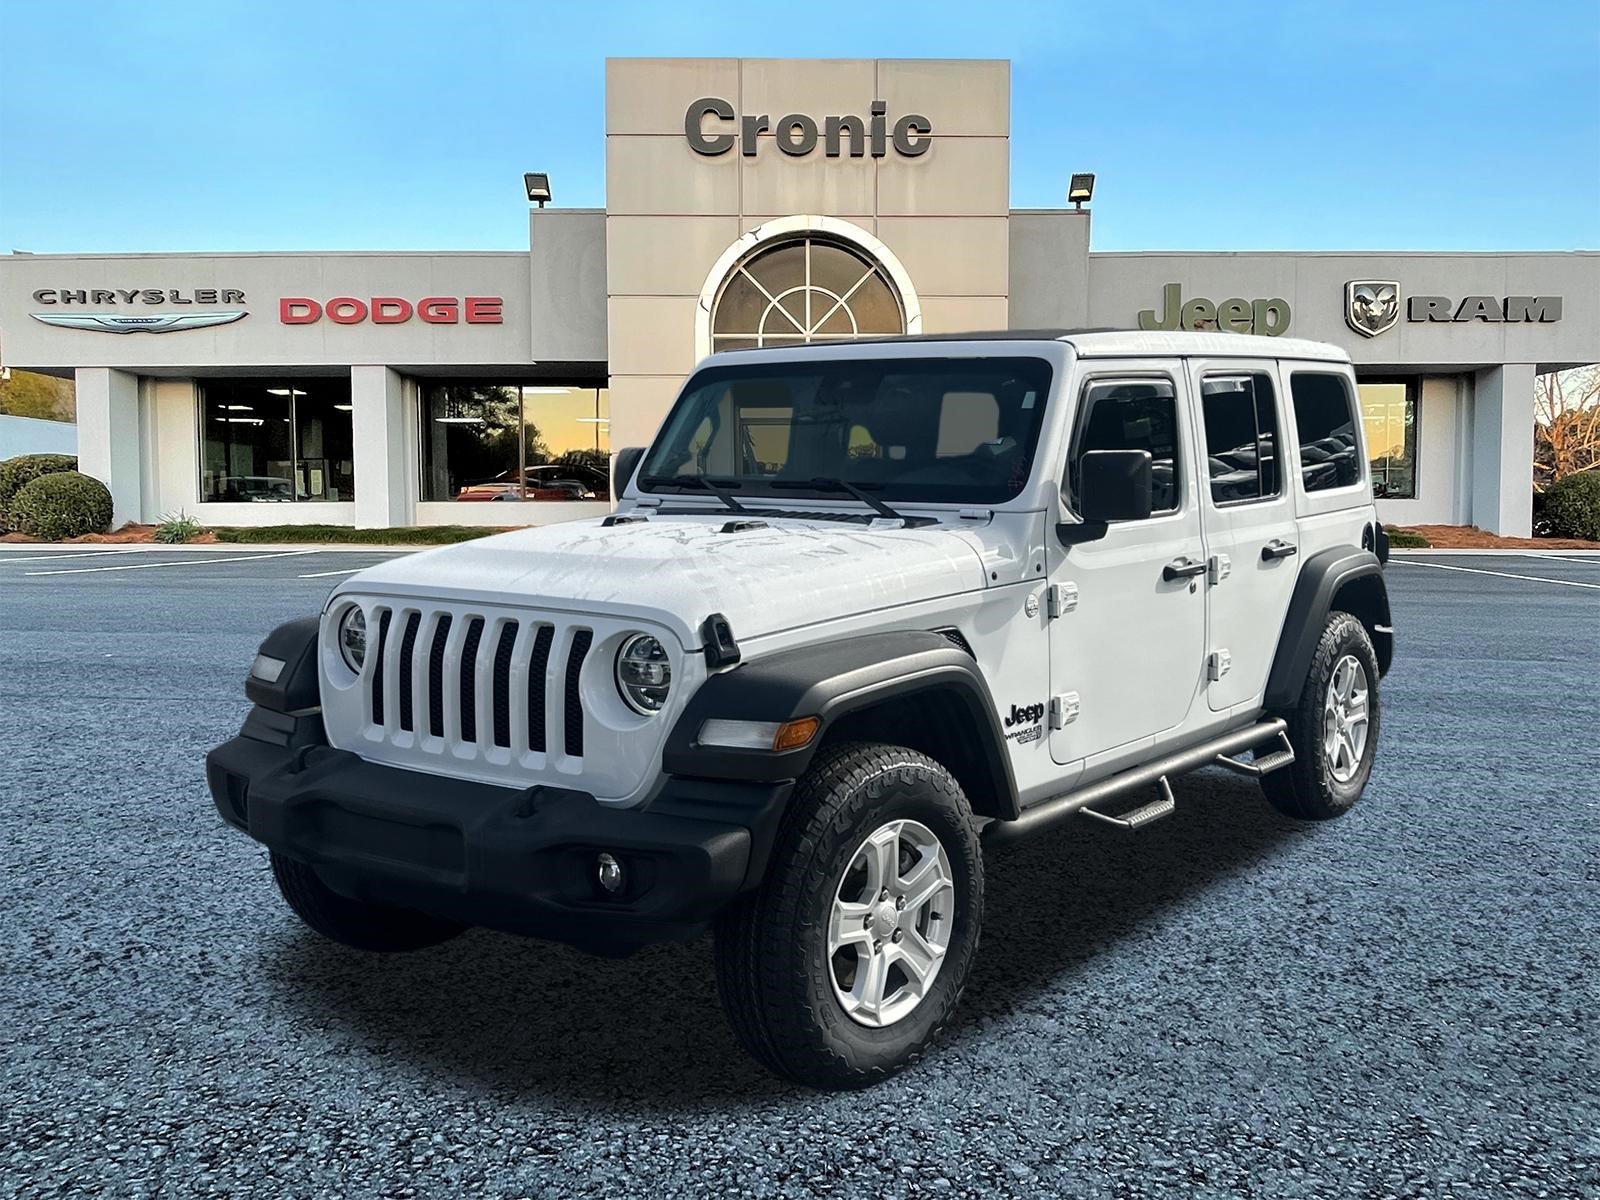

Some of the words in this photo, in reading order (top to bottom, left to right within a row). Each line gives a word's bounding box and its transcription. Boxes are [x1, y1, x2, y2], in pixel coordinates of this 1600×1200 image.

[685, 97, 933, 157] Cronic
[33, 288, 247, 305] CHRYSLER
[1407, 296, 1563, 322] RAM
[280, 298, 504, 325] DODGE
[1138, 283, 1292, 337] Jeep
[1005, 702, 1044, 727] Jeep
